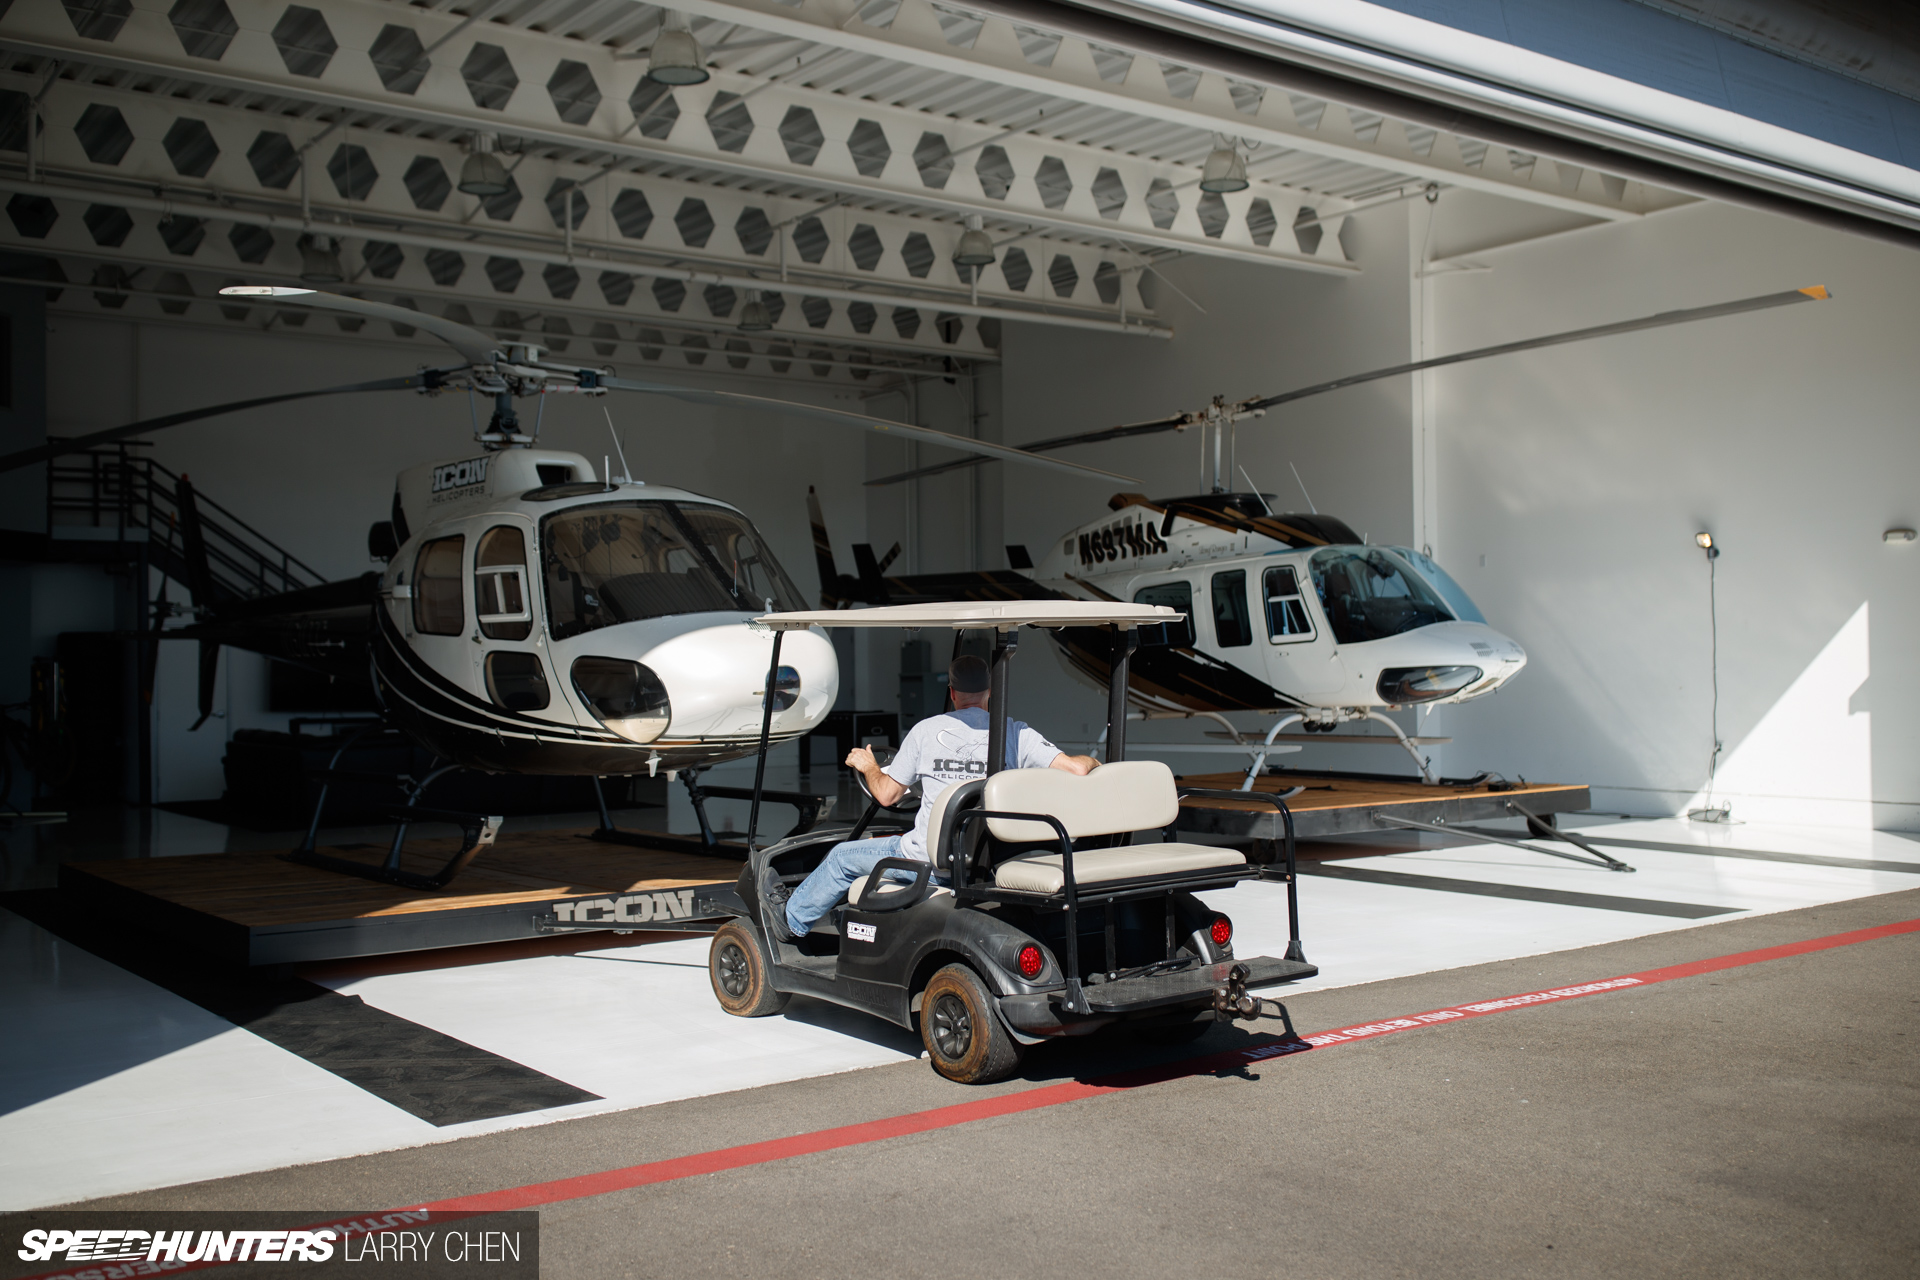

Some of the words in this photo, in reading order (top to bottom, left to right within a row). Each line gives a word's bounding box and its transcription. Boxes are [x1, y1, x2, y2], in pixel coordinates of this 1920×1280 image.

[432, 456, 491, 493] ICON
[432, 485, 485, 503] HELICOPTERS
[1079, 521, 1168, 566] N697MA
[933, 758, 988, 774] ICO
[553, 889, 695, 931] ICON
[847, 922, 876, 937] ICON
[1413, 1011, 1464, 1023] ONLY
[1342, 1018, 1422, 1037] BEYOND
[1300, 1033, 1350, 1046] THIS
[1242, 1041, 1307, 1059] POINT
